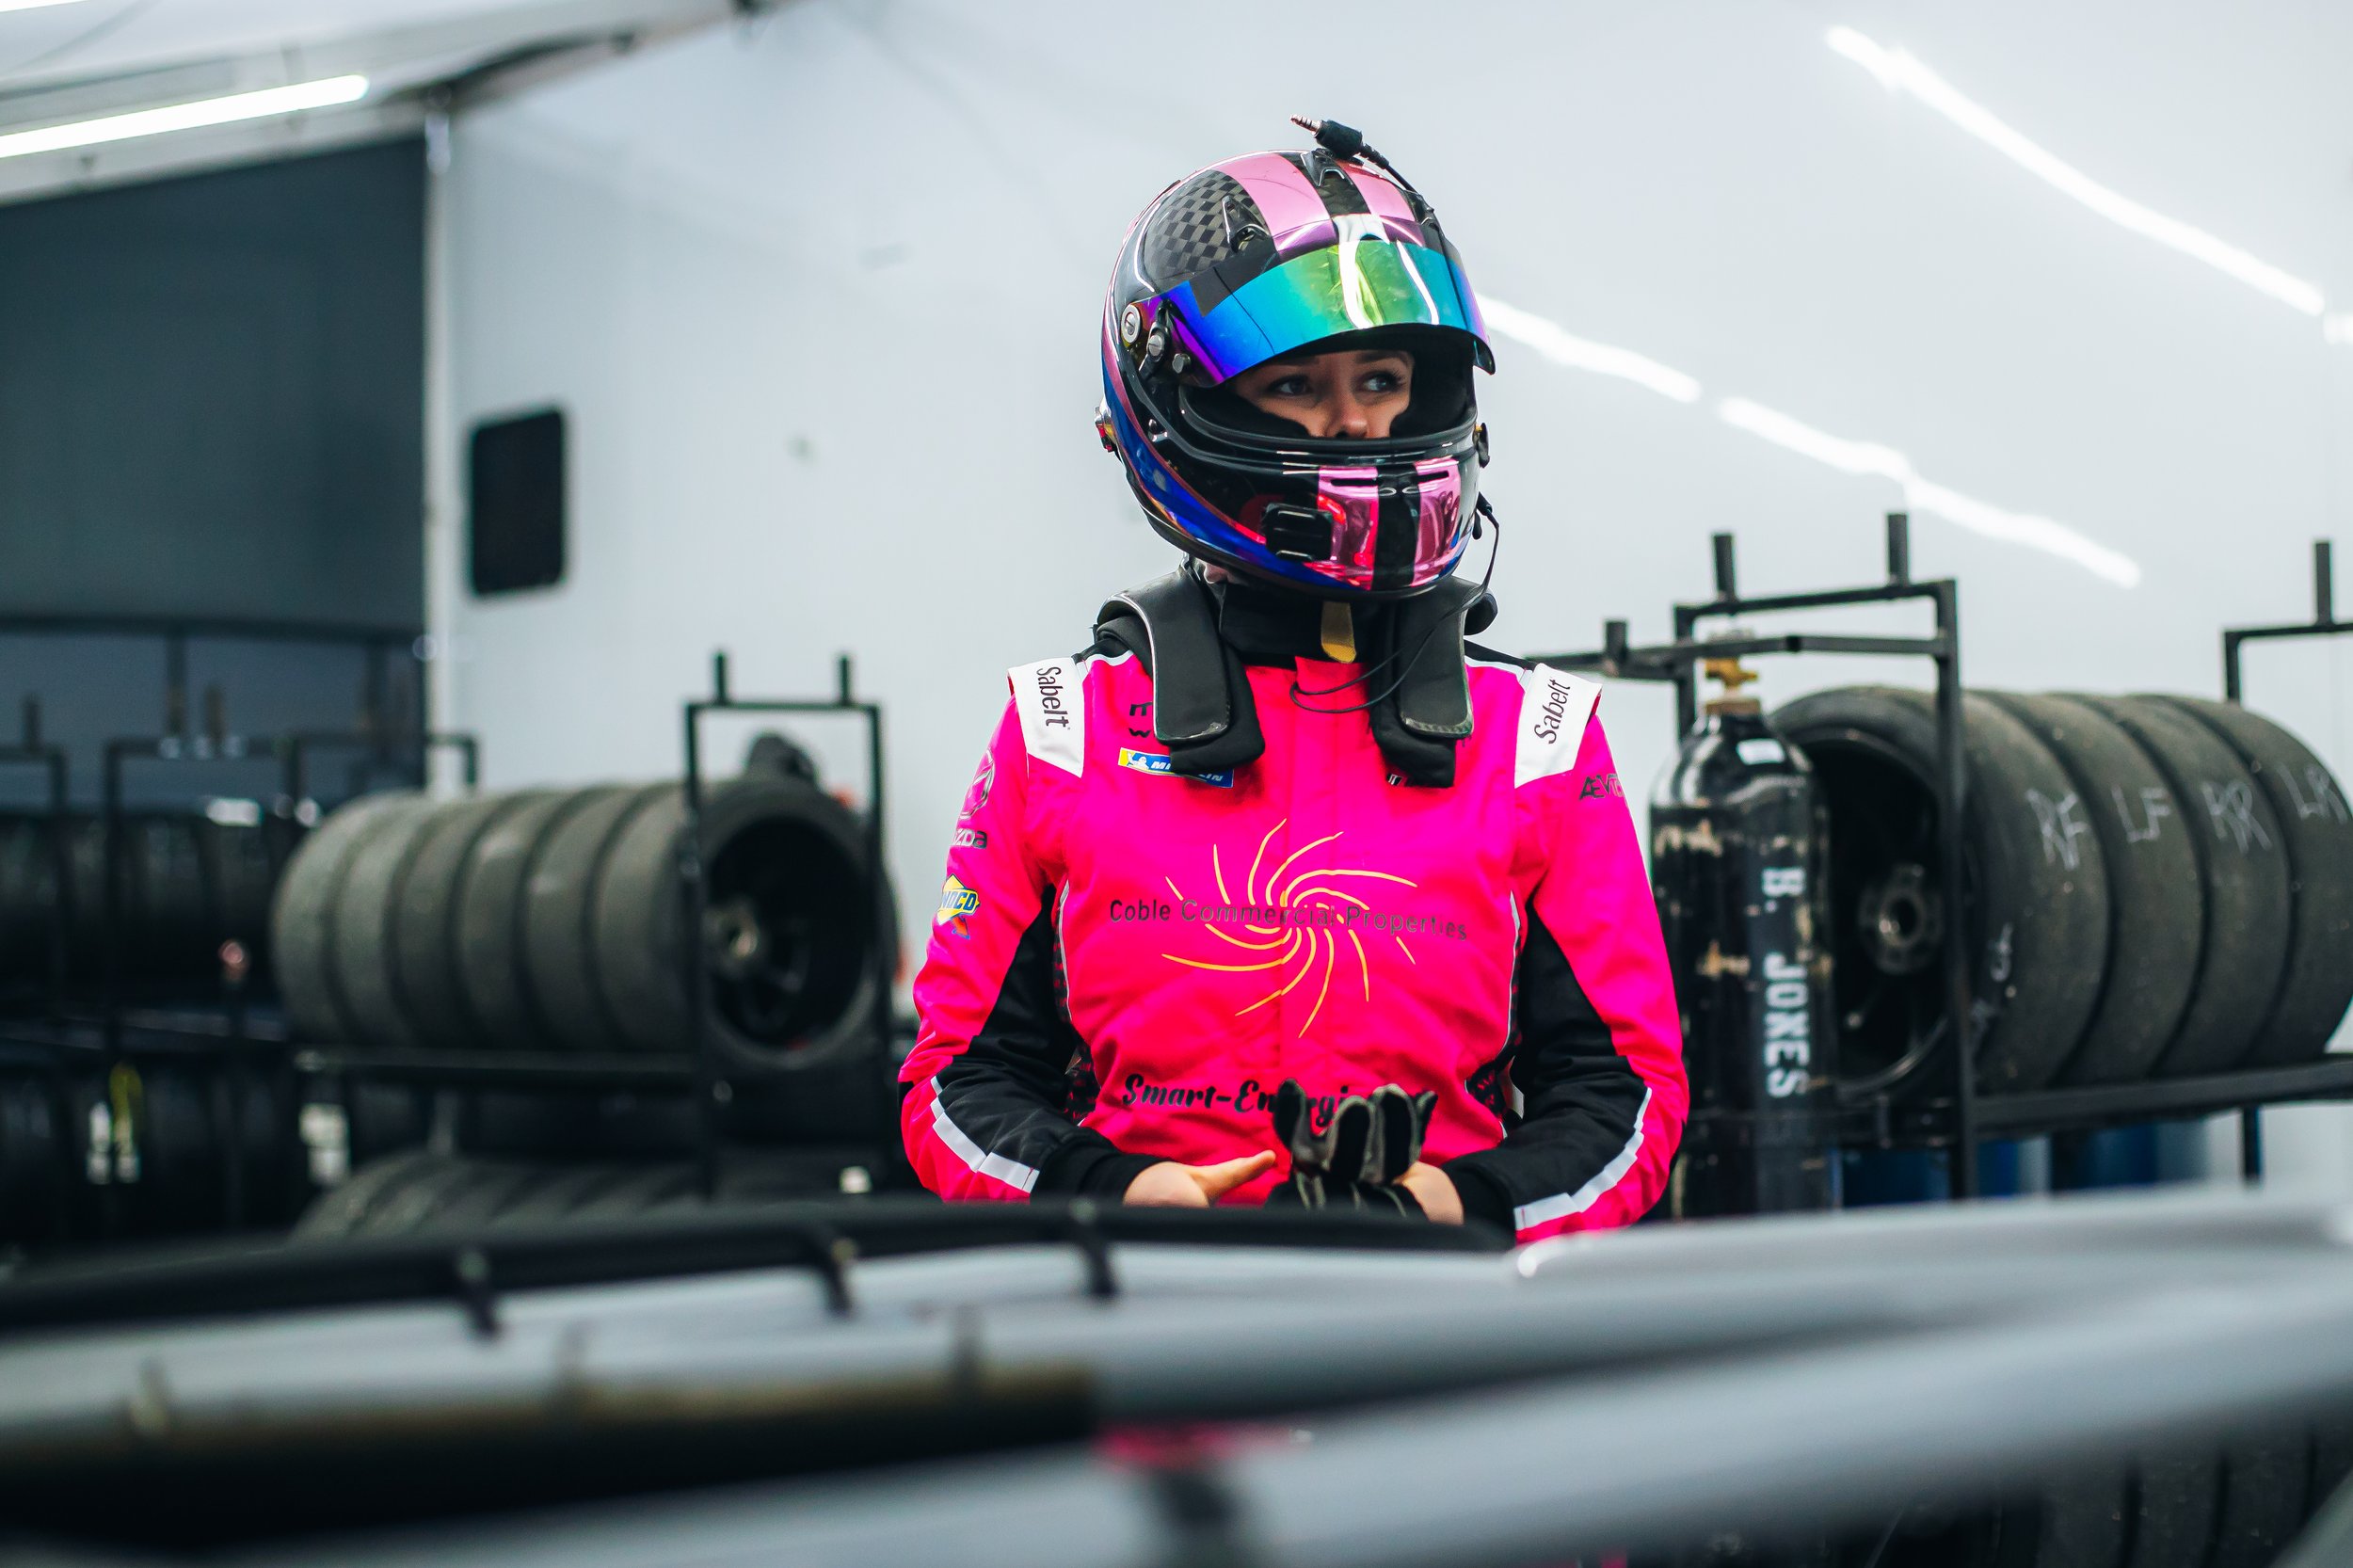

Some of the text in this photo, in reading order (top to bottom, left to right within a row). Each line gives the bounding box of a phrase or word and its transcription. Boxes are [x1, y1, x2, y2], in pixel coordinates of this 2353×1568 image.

[1036, 666, 1069, 728] Sabelt
[1534, 677, 1571, 744] Sabelt
[1150, 760, 1224, 781] MIIN
[2111, 785, 2170, 843] LF
[941, 891, 977, 912] NOCO
[1110, 899, 1467, 941] Coble Commercial Properties
